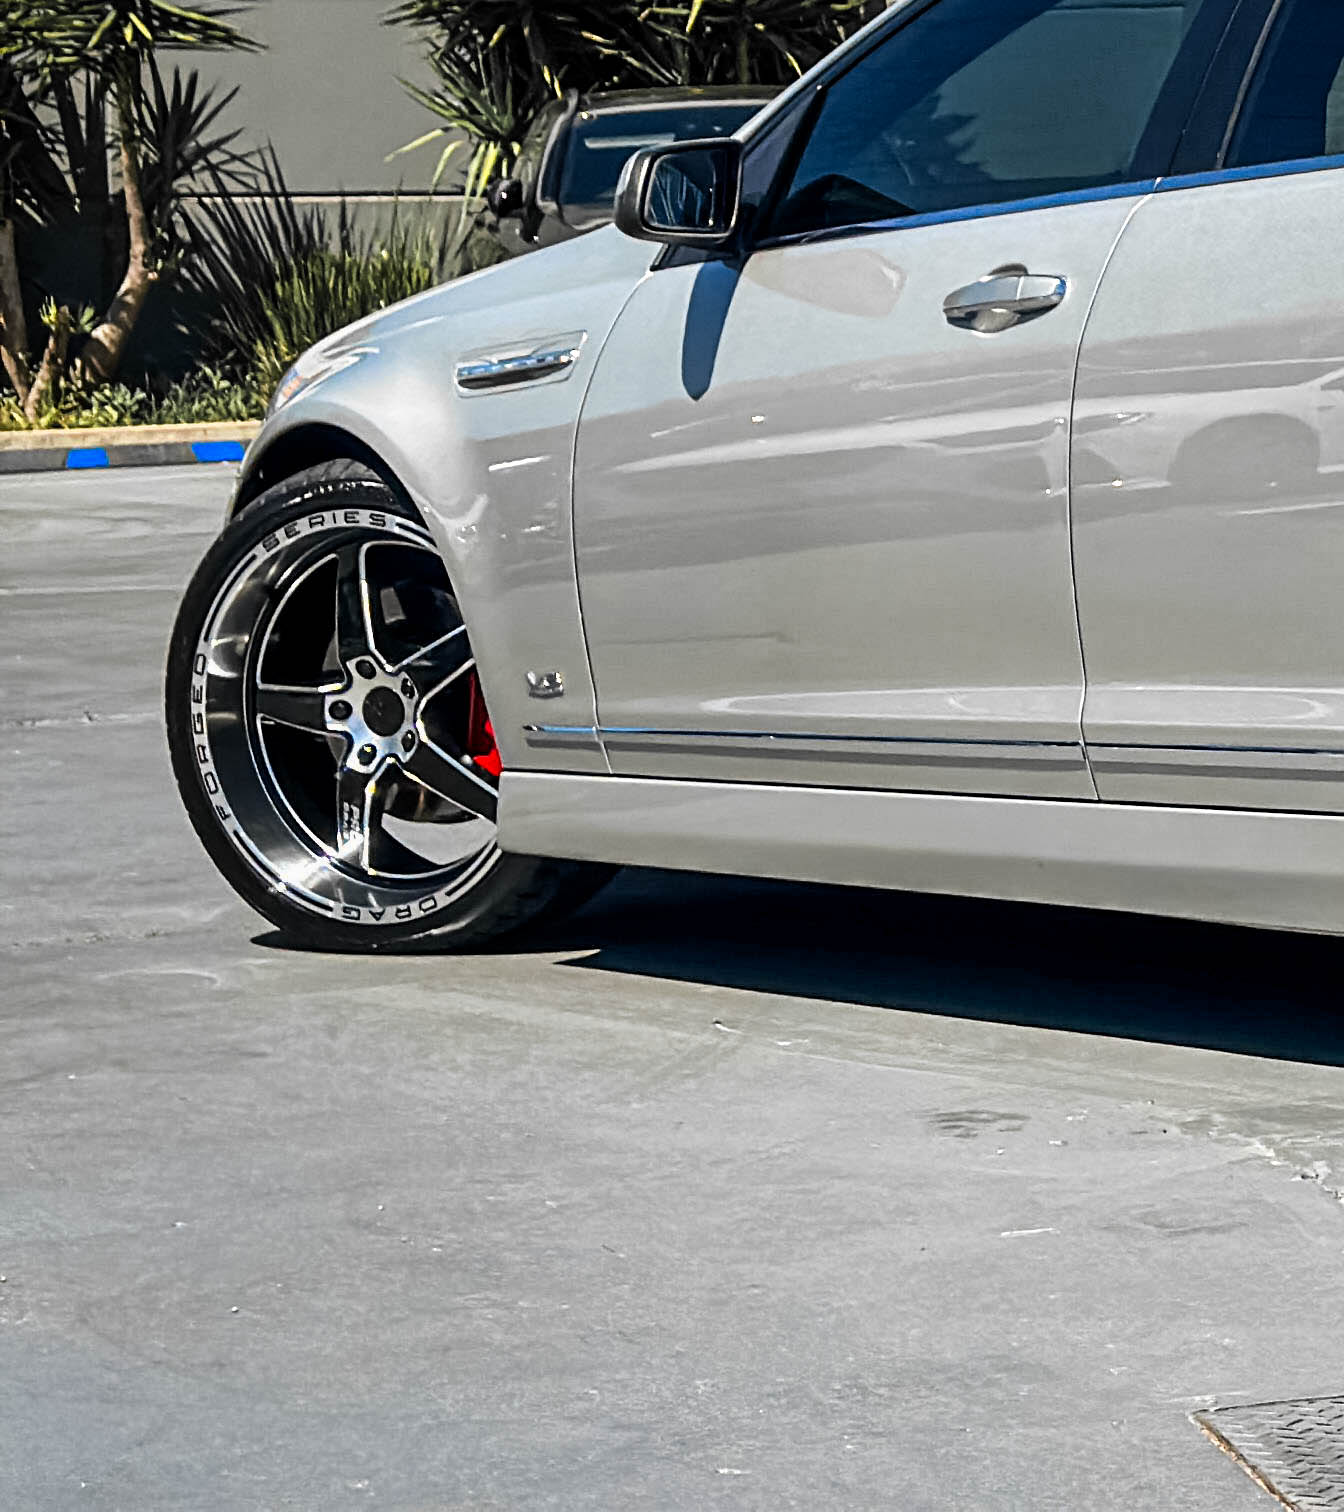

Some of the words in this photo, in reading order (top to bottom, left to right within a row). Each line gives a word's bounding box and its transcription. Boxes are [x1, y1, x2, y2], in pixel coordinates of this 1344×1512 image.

[262, 511, 387, 553] SERIES
[193, 653, 231, 821] FORGED
[342, 896, 437, 921] DRAG
